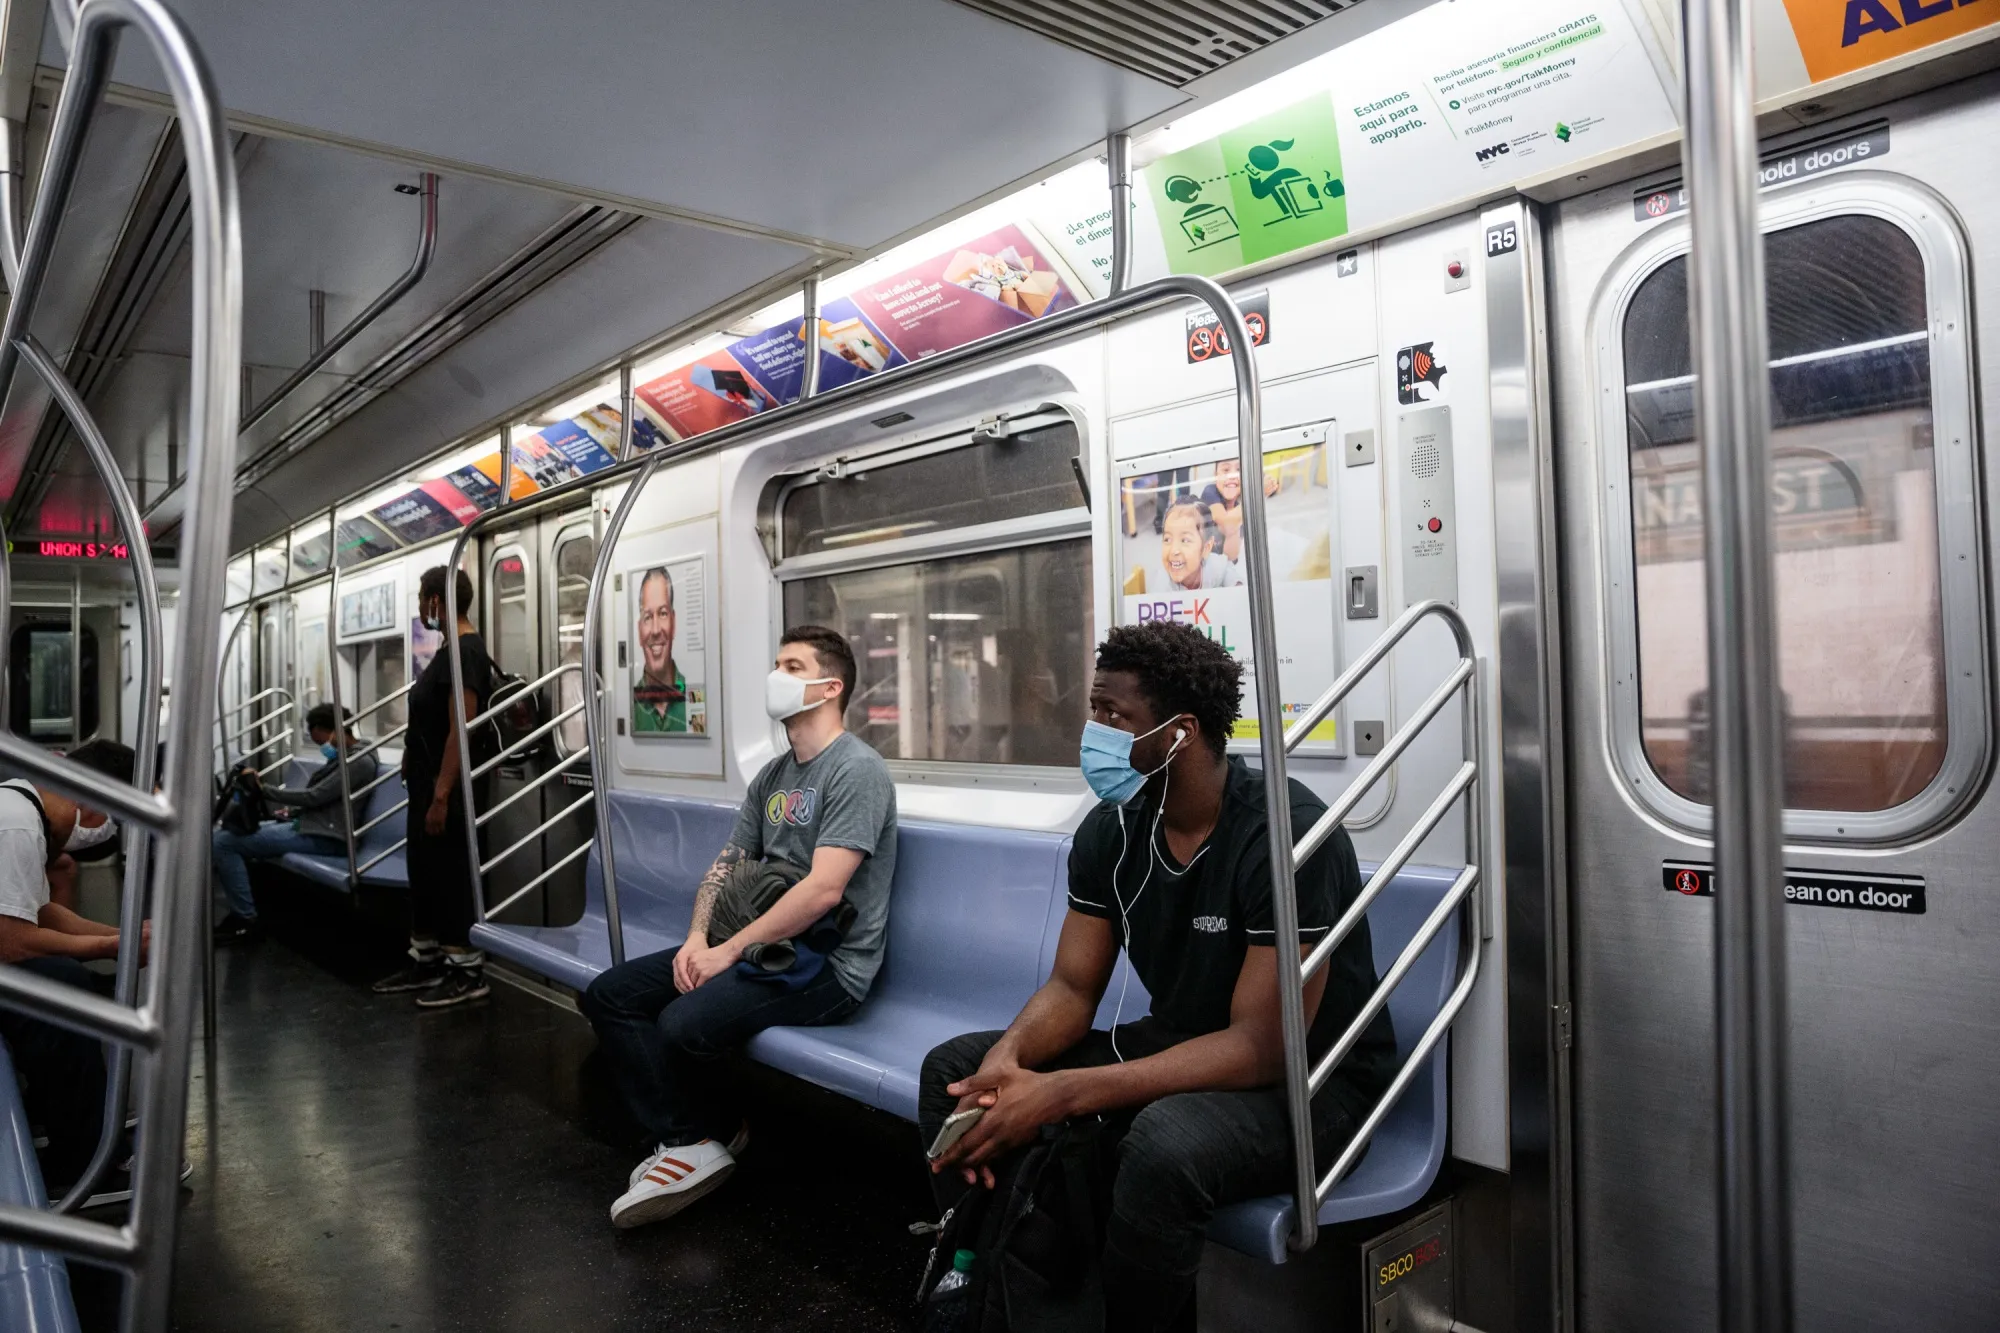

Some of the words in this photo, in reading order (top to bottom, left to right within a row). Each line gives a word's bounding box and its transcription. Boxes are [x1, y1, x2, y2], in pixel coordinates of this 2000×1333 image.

[1433, 67, 1465, 84] Reciba
[1507, 31, 1557, 57] financiera
[1558, 14, 1598, 35] GRATIS
[1440, 83, 1455, 95] por
[1502, 52, 1534, 70] Seguro
[1536, 49, 1543, 59] y
[1543, 25, 1601, 55] confidencial
[1461, 90, 1486, 106] Visite
[1486, 57, 1577, 96] nyc.gov/TalkMoney
[1467, 102, 1487, 115] para
[1488, 85, 1533, 108] programar
[1533, 77, 1551, 90] una
[1552, 71, 1573, 86] cita.
[1353, 91, 1410, 117] Estamos
[1388, 104, 1418, 122] para
[1369, 119, 1427, 144] apoyarlo.
[1464, 115, 1513, 136] #TalkMoney
[1475, 142, 1510, 162] NYC
[1804, 141, 1870, 169] doors
[1075, 235, 1087, 246] el
[1087, 225, 1112, 241] diner
[1488, 226, 1516, 252] R5
[1091, 257, 1109, 268] No
[1187, 312, 1220, 330] Pleas
[40, 542, 82, 556] UNION
[1138, 598, 1211, 625] PRE-K
[1783, 884, 1822, 901] ean
[1826, 887, 1855, 904] on
[1859, 886, 1913, 908] door
[1380, 1253, 1414, 1285] SBCO
